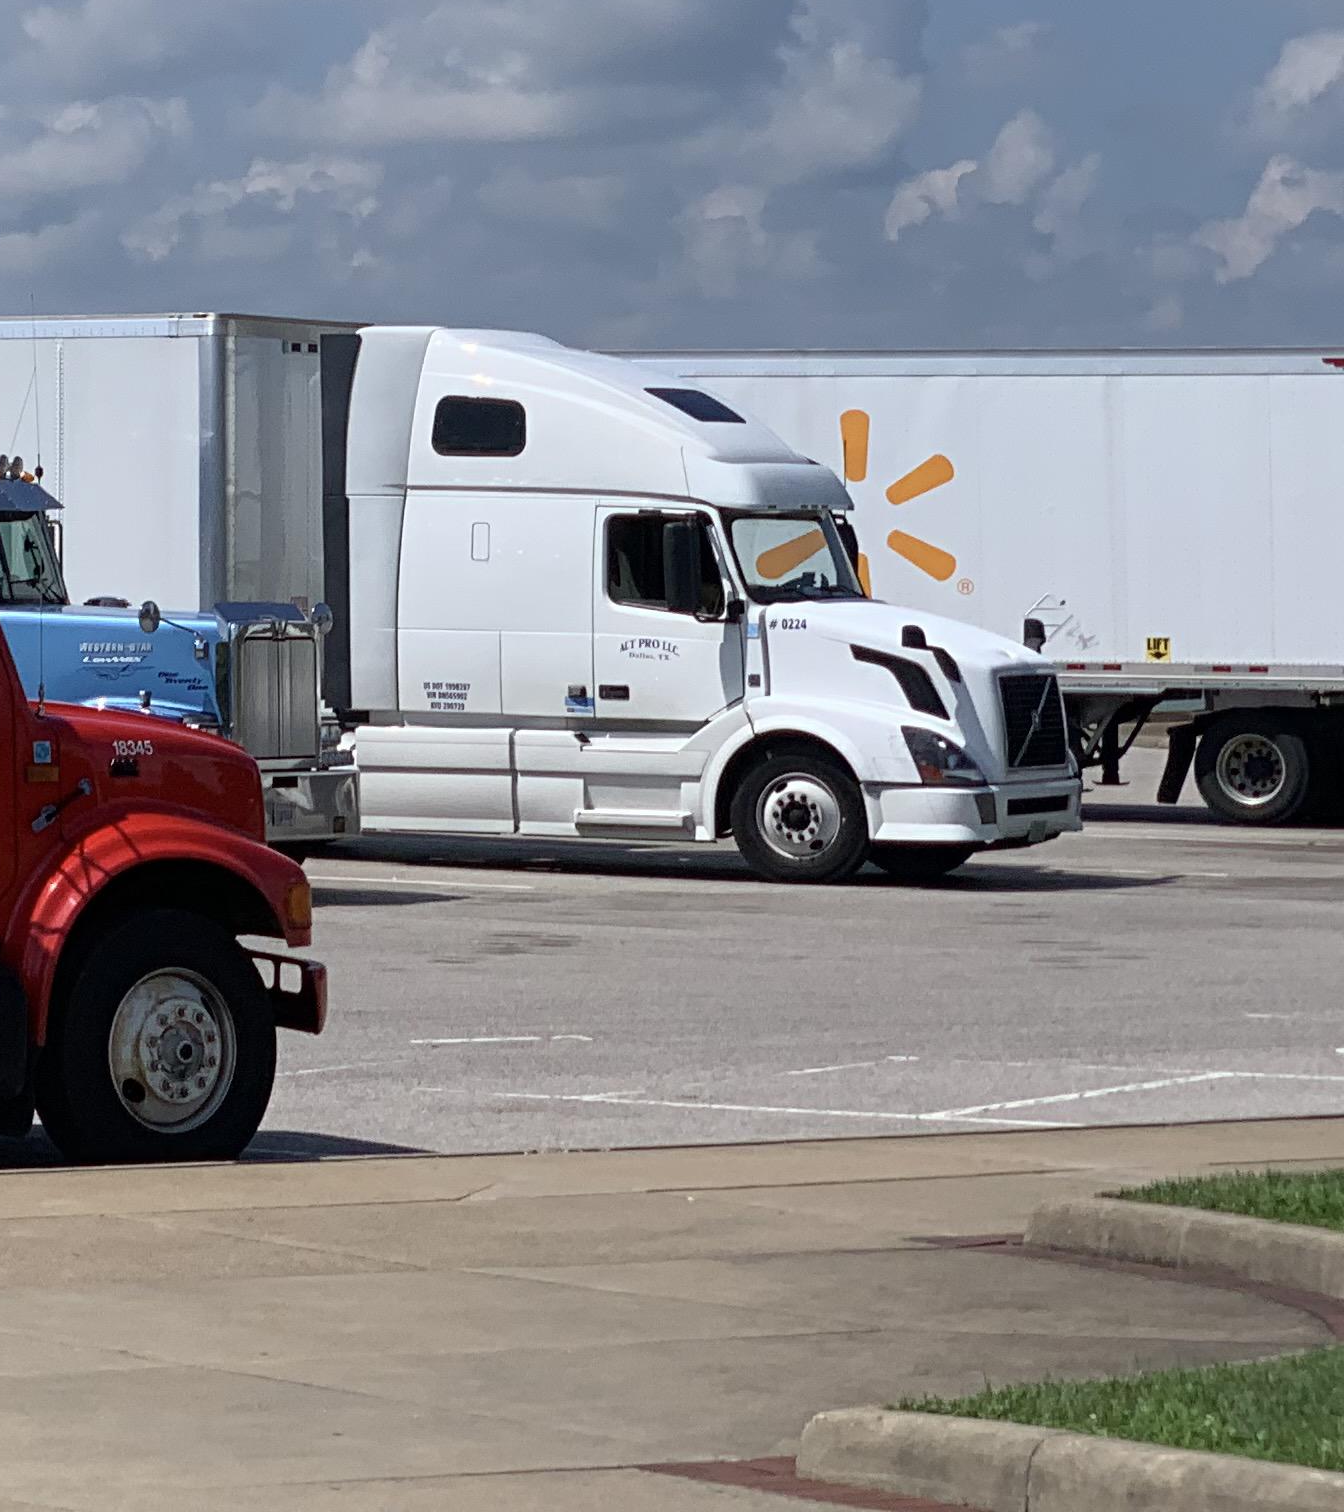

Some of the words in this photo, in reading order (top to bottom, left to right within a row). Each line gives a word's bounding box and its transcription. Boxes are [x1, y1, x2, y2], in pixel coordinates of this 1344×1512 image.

[782, 618, 808, 631] 0224
[638, 638, 660, 649] PRO
[1147, 637, 1170, 651] LIFT
[112, 740, 154, 757] 18345
